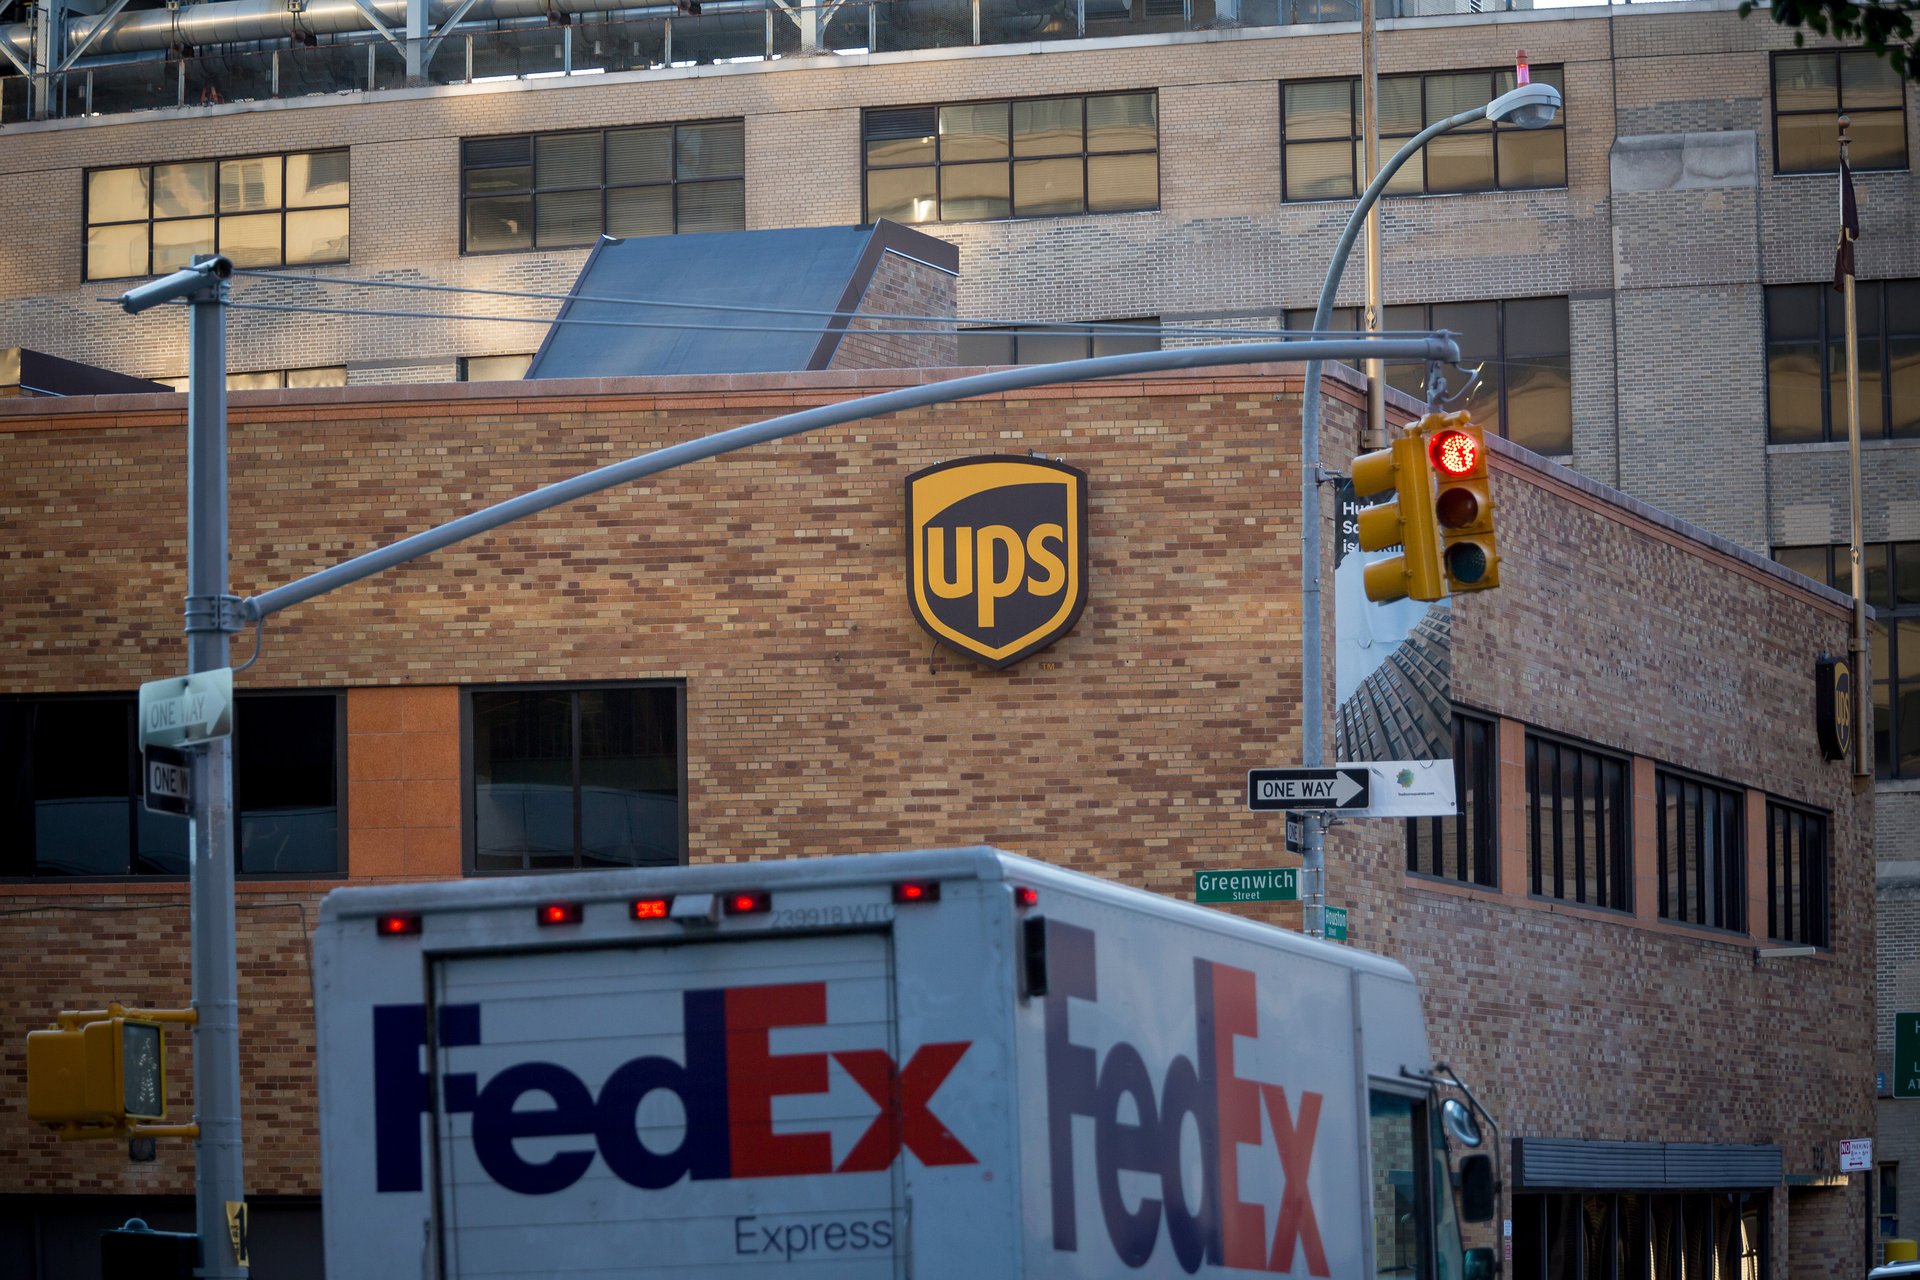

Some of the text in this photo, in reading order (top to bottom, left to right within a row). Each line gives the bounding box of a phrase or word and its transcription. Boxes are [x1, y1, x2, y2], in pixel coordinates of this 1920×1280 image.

[927, 523, 1066, 628] ups
[151, 694, 205, 729] ONE WAY
[154, 765, 177, 793] ONE
[1263, 781, 1335, 797] ONE WAY
[1199, 871, 1293, 891] Greenwich
[1233, 891, 1260, 900] Street
[1326, 909, 1346, 927] Houston
[373, 982, 979, 1195] FedEx
[1044, 918, 1331, 1278] FedEx
[1841, 1142, 1850, 1154] NO
[735, 1216, 893, 1262] Express
